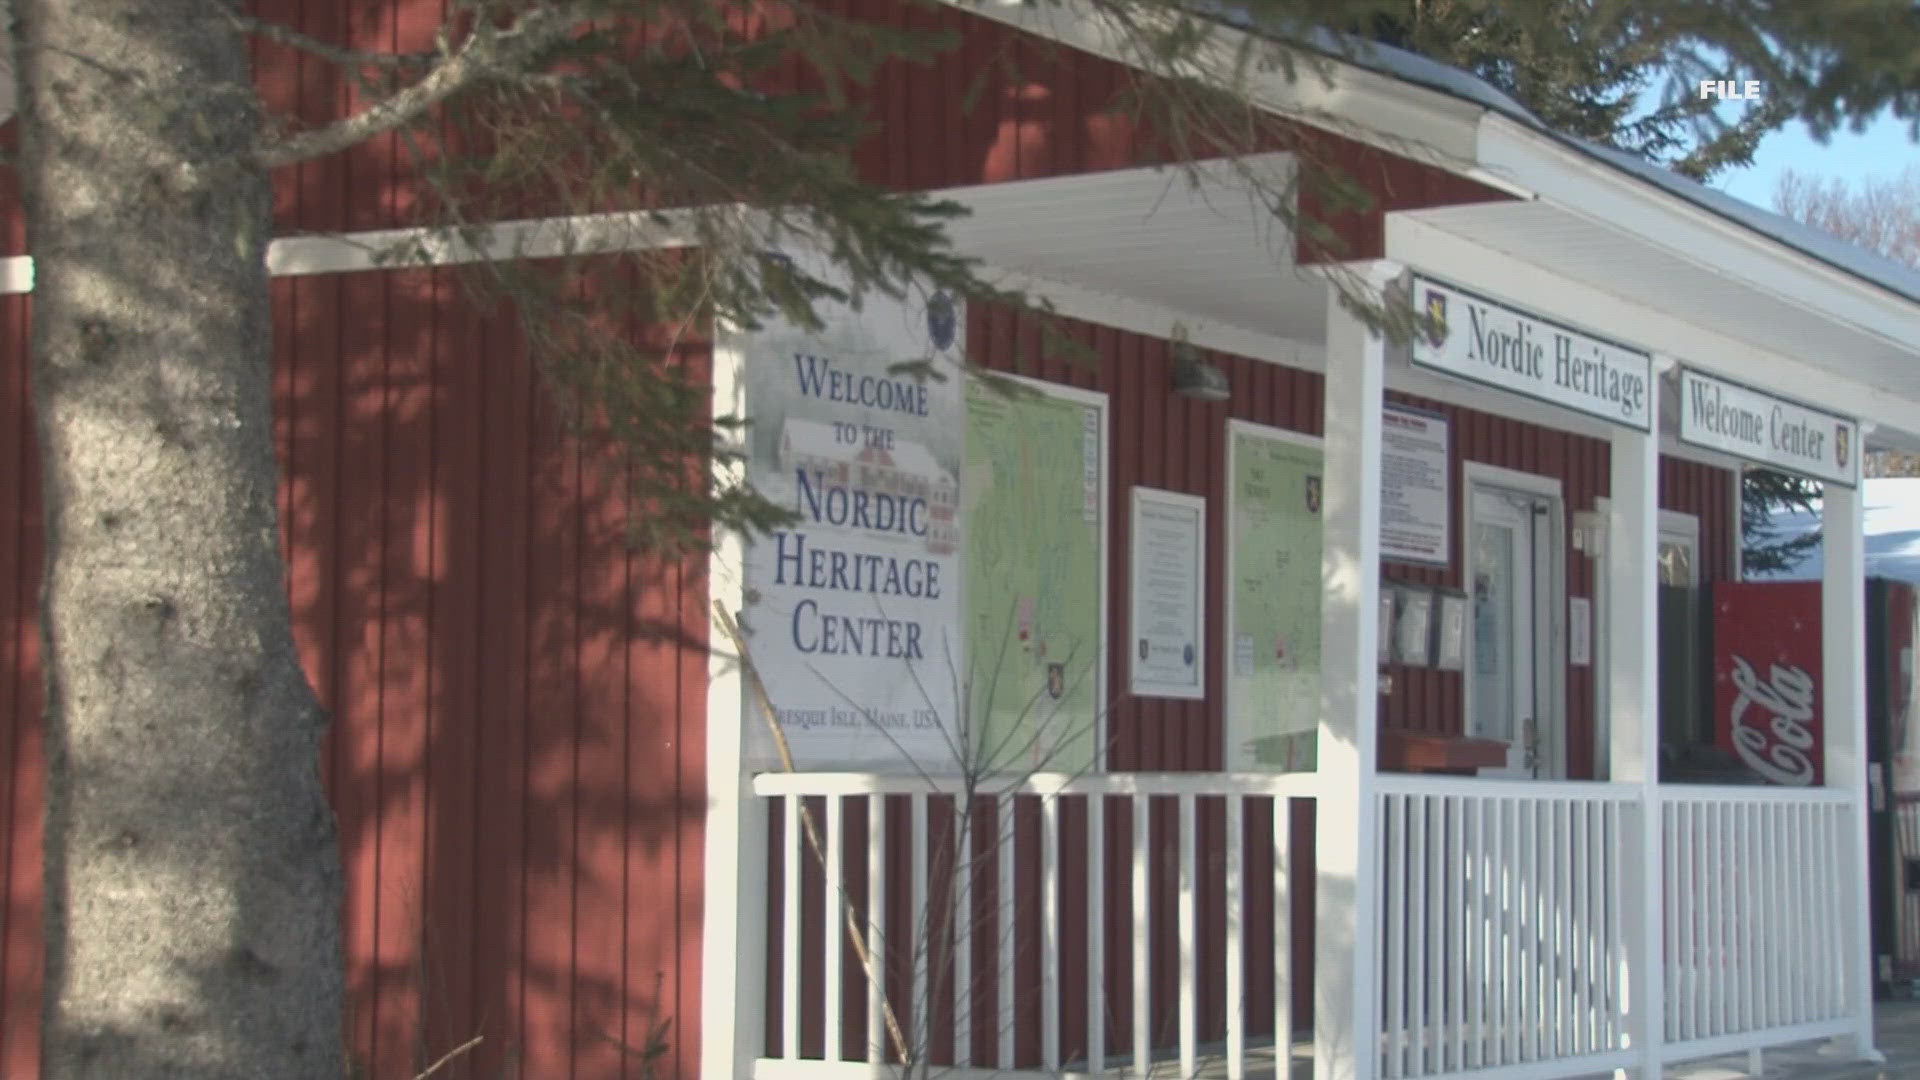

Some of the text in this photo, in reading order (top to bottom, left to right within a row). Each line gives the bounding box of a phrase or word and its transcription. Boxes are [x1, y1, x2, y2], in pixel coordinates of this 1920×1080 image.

[794, 353, 929, 418] WELCOME
[1467, 303, 1644, 417] Nordic Heritage
[833, 421, 895, 451] TO THE
[1690, 378, 1824, 461] Welcome Center
[795, 468, 928, 537] NORDIC
[774, 531, 941, 600] HERITAGE
[792, 599, 924, 660] CENTER
[1730, 653, 1815, 786] Cola
